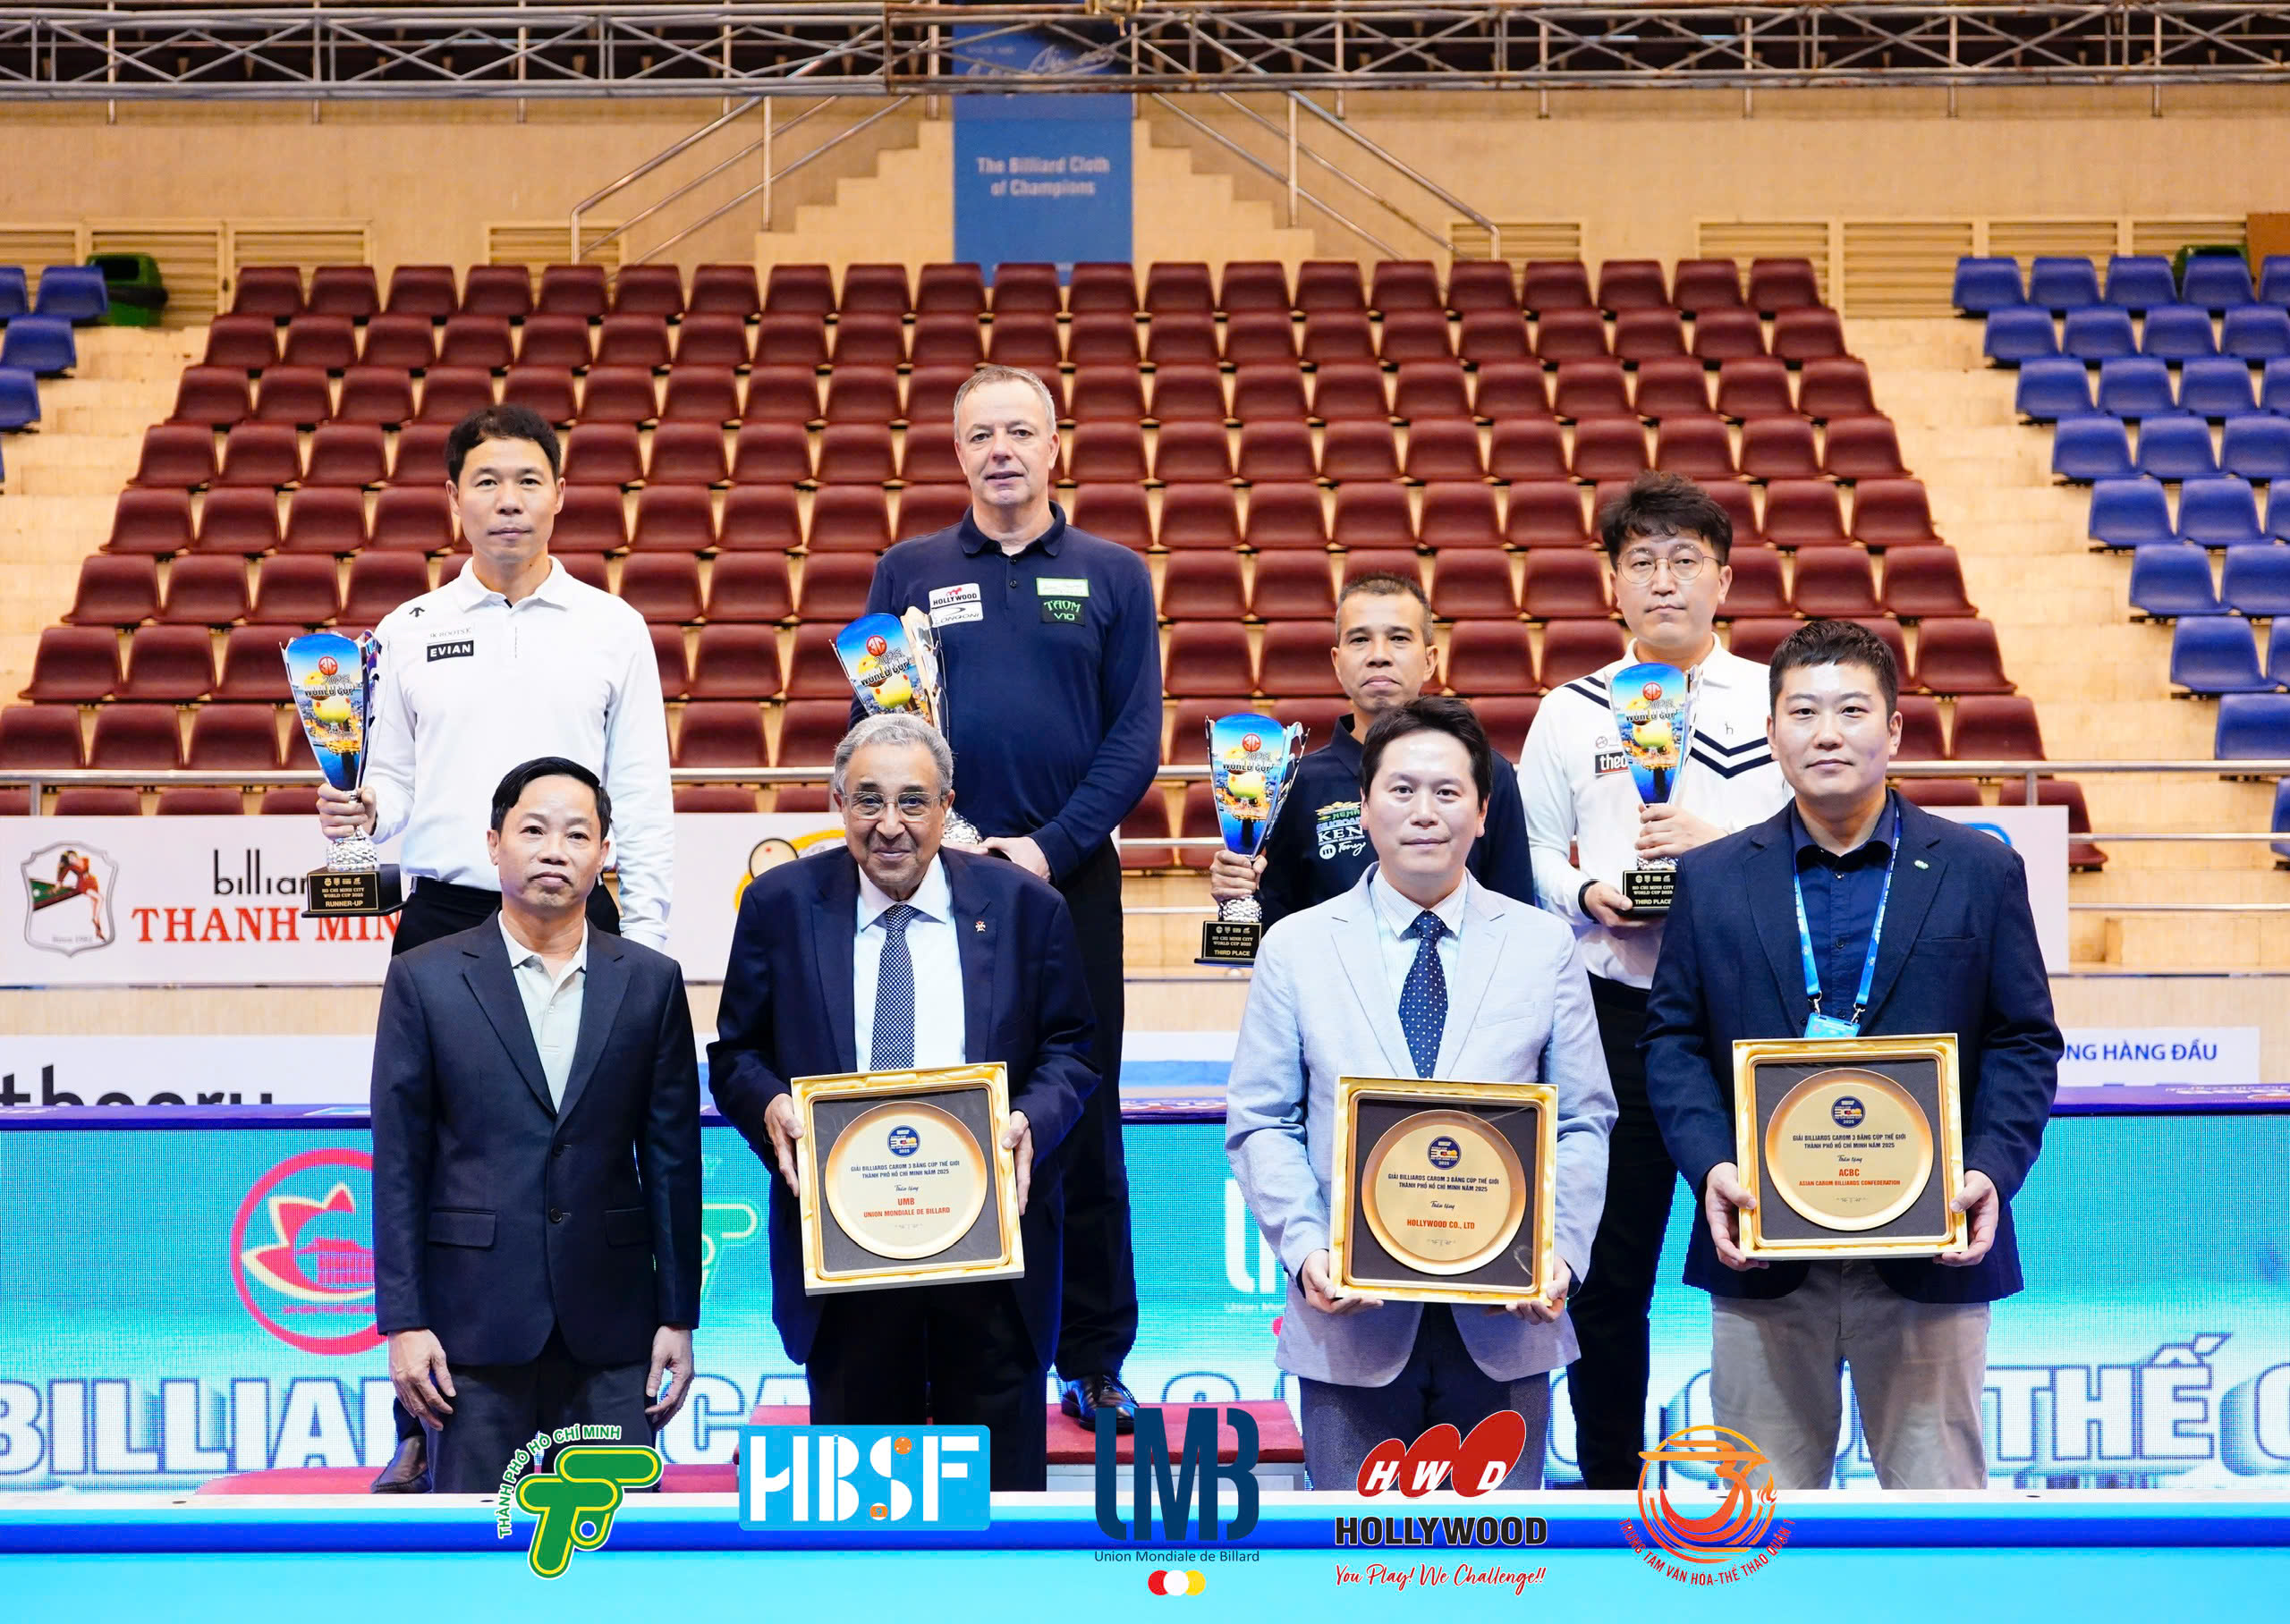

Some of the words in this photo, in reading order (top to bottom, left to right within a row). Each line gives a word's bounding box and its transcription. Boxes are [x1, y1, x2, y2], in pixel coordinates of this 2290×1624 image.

[978, 156, 1005, 173] The
[933, 592, 978, 605] HOLLYWOOD
[430, 644, 471, 657] EVIAN
[1599, 753, 1628, 770] theo
[214, 849, 308, 896] billiar
[131, 908, 301, 942] THANH
[315, 909, 401, 942] MIN
[2066, 1044, 2097, 1061] NG
[2103, 1038, 2166, 1061] HÀNG
[1839, 1168, 1860, 1176] ACBC
[897, 1197, 915, 1205] UMB
[863, 1210, 883, 1218] UNION
[884, 1209, 914, 1217] MONDIALE
[926, 1206, 950, 1214] BILLARD
[1407, 1219, 1446, 1228] HOLLYWOOD
[1449, 1221, 1462, 1230] CO.,
[1982, 1332, 2233, 1461] THẾ
